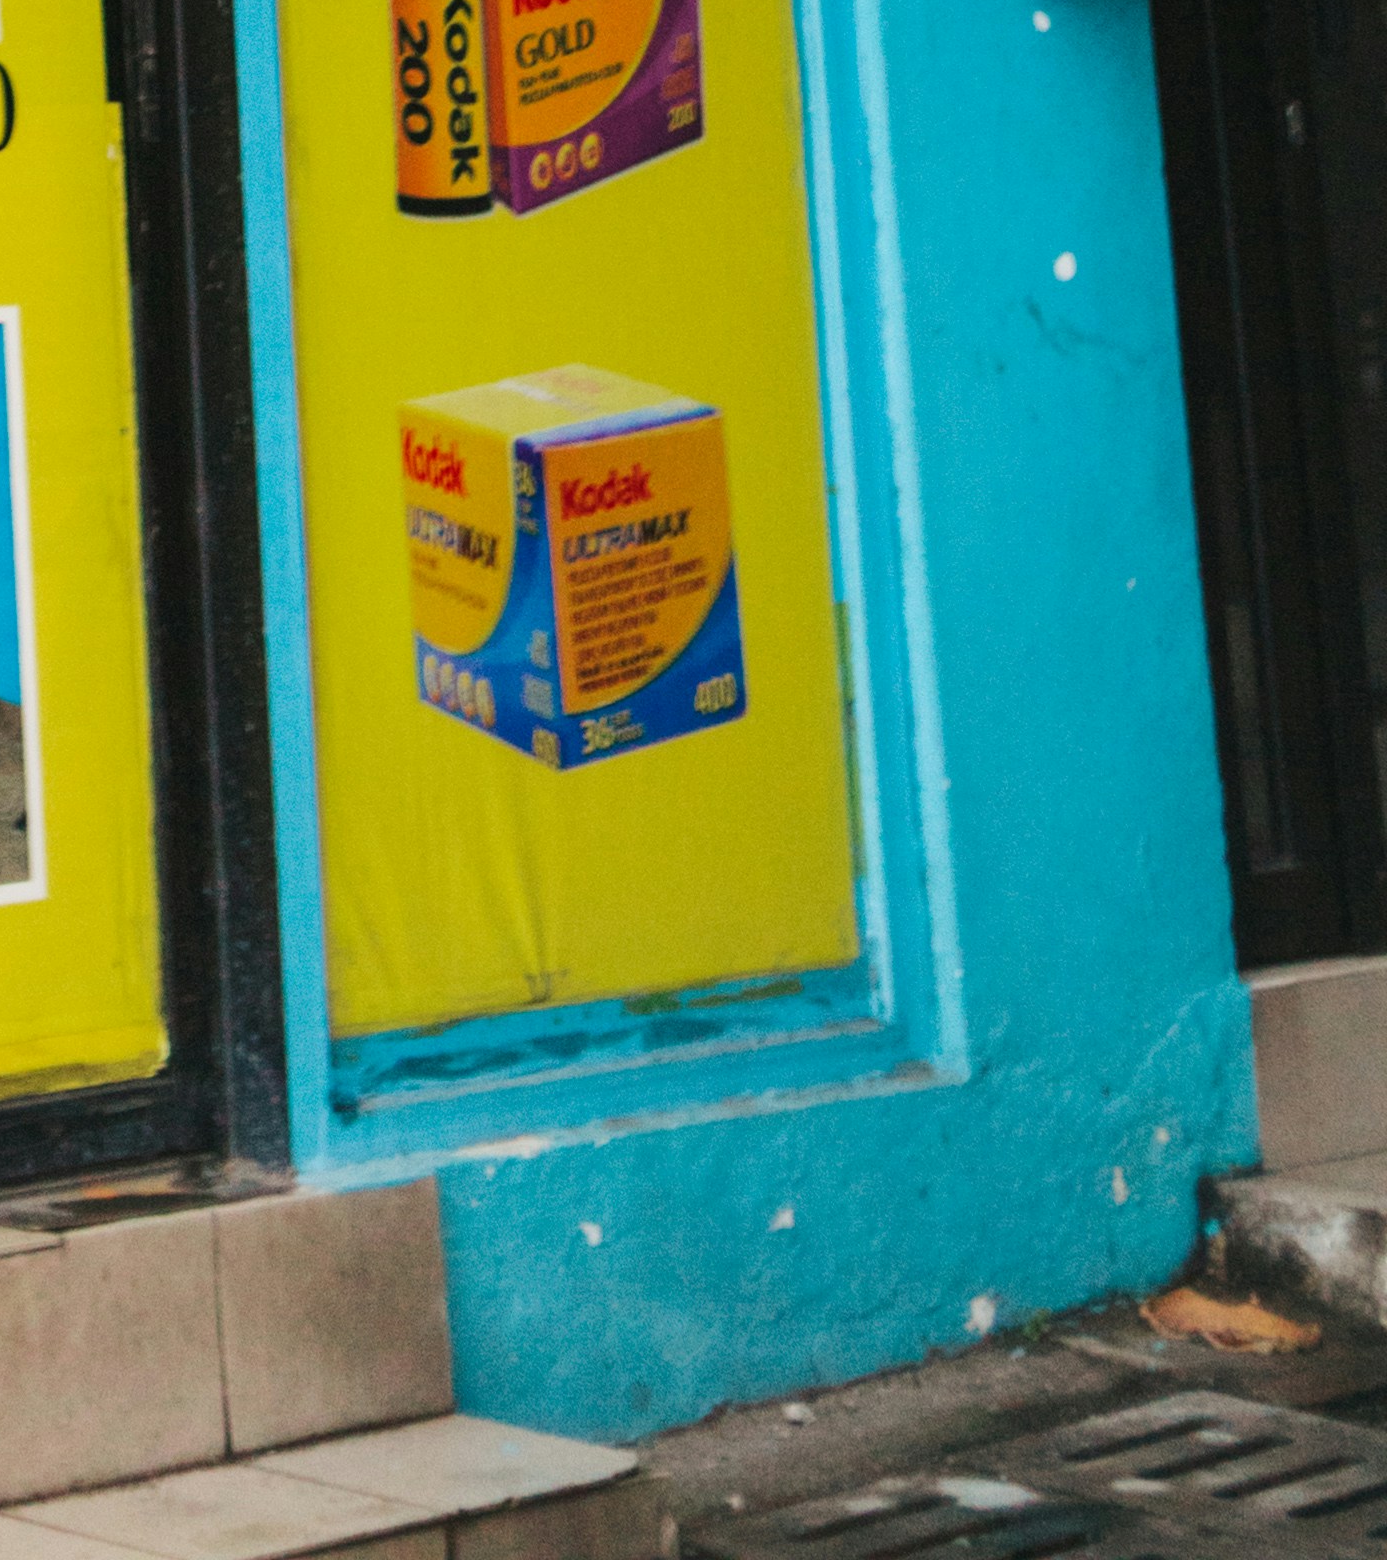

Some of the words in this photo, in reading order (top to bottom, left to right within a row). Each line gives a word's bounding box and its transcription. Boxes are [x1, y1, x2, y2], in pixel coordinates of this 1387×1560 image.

[515, 17, 595, 69] GOLD
[398, 17, 434, 146] 200
[559, 462, 654, 521] Kodak
